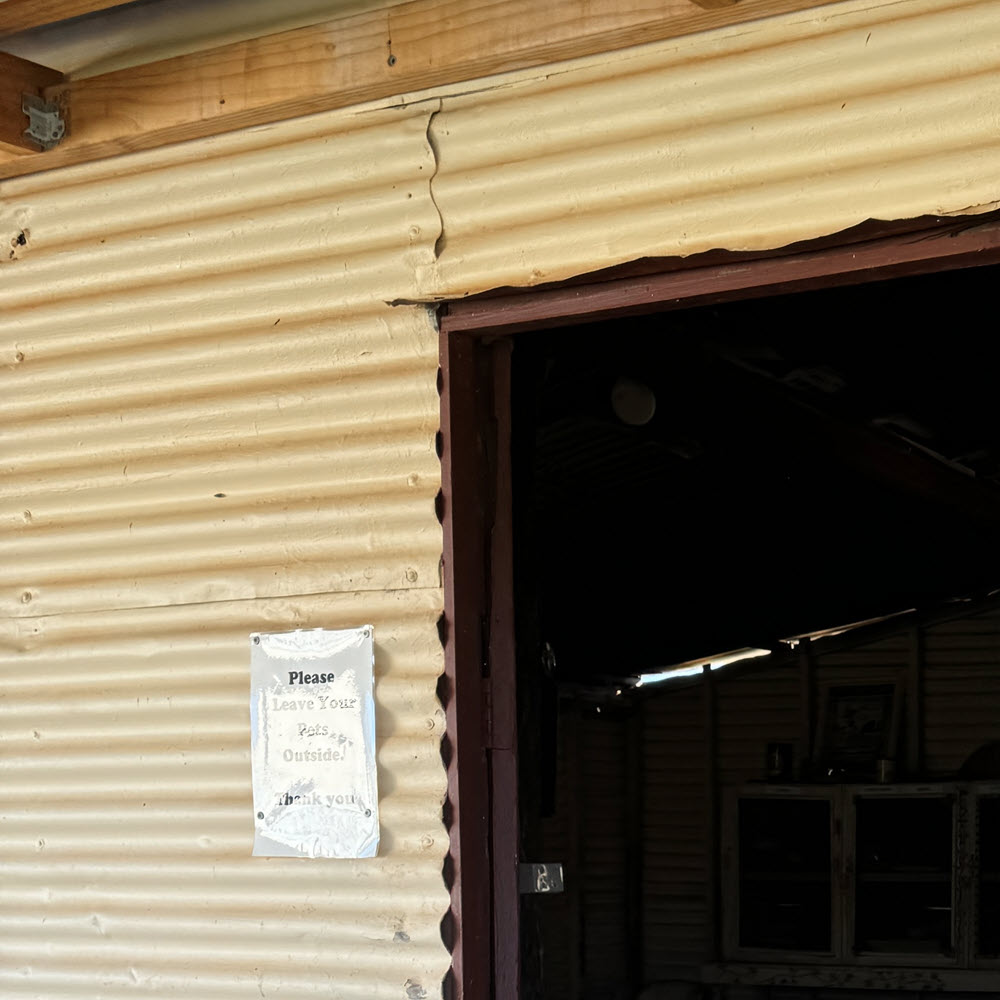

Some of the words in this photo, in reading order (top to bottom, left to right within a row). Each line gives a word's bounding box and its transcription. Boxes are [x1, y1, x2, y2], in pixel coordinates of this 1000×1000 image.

[288, 671, 335, 685] Please
[272, 698, 315, 711] Leave
[318, 695, 357, 710] Your
